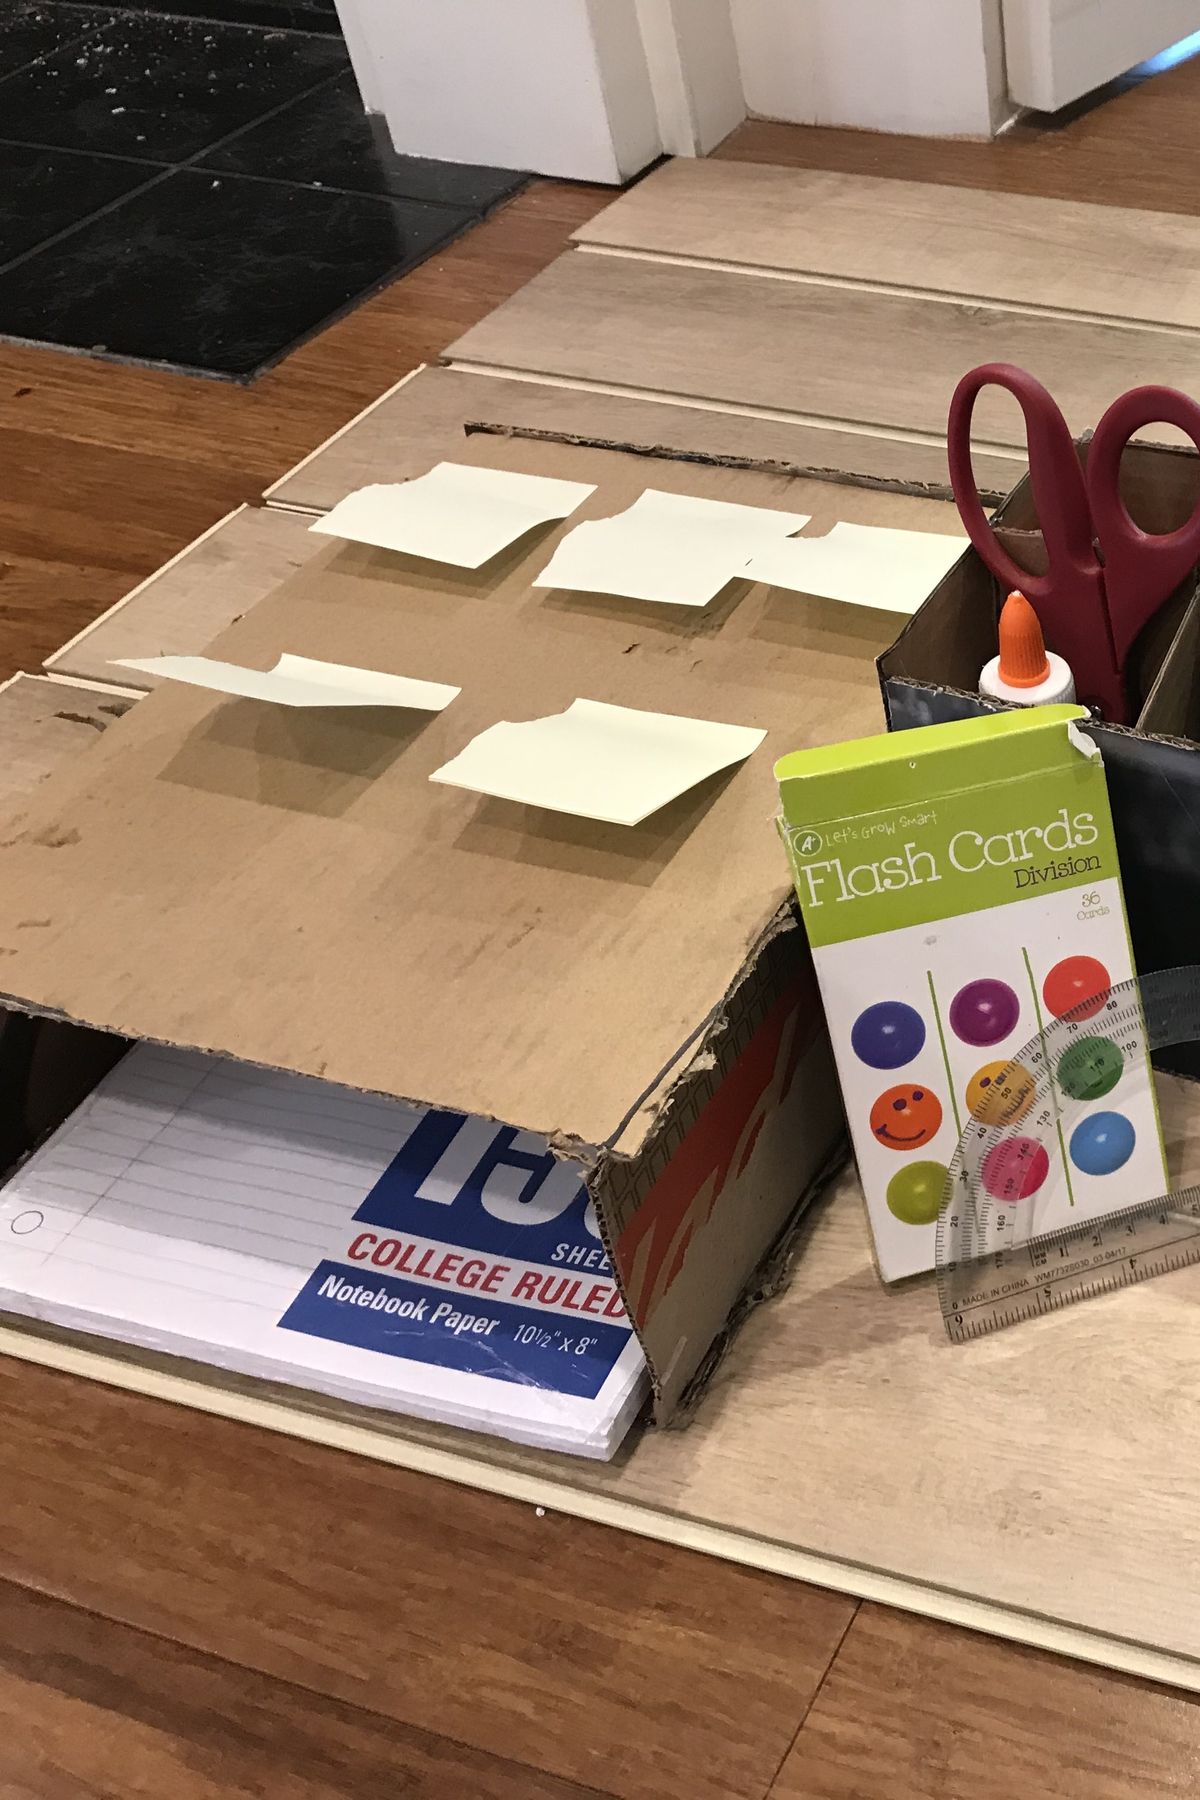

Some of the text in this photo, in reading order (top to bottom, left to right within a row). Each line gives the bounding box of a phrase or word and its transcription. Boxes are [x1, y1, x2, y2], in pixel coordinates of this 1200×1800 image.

[801, 808, 1099, 907] Flash Cards
[1014, 855, 1101, 889] Division
[1076, 905, 1111, 922] Cards
[1081, 890, 1101, 908] 36
[950, 1214, 959, 1228] 20
[959, 1169, 969, 1182] 30
[976, 1126, 987, 1140] 40
[1000, 1086, 1012, 1100] 50
[1031, 1051, 1043, 1064] 60
[1066, 1022, 1079, 1034] 70
[1105, 1000, 1118, 1011] 80
[997, 1214, 1006, 1232] 160
[1003, 1177, 1015, 1195] 150
[1035, 1110, 1051, 1127] 130
[1060, 1081, 1076, 1097] 120
[1089, 1057, 1105, 1073] 110
[1121, 1040, 1138, 1053] 100
[414, 1113, 603, 1240] 15
[1092, 1235, 1100, 1247] 2
[1125, 1225, 1133, 1237] 3
[1191, 1203, 1199, 1215] 5
[347, 1232, 628, 1319] COLLEGE RULED
[549, 1242, 616, 1275] SHEE
[317, 1274, 428, 1321] Notebook
[429, 1304, 501, 1337] Paper
[961, 1293, 988, 1306] MADE
[990, 1288, 1000, 1298] IN
[1001, 1279, 1030, 1294] CHINA
